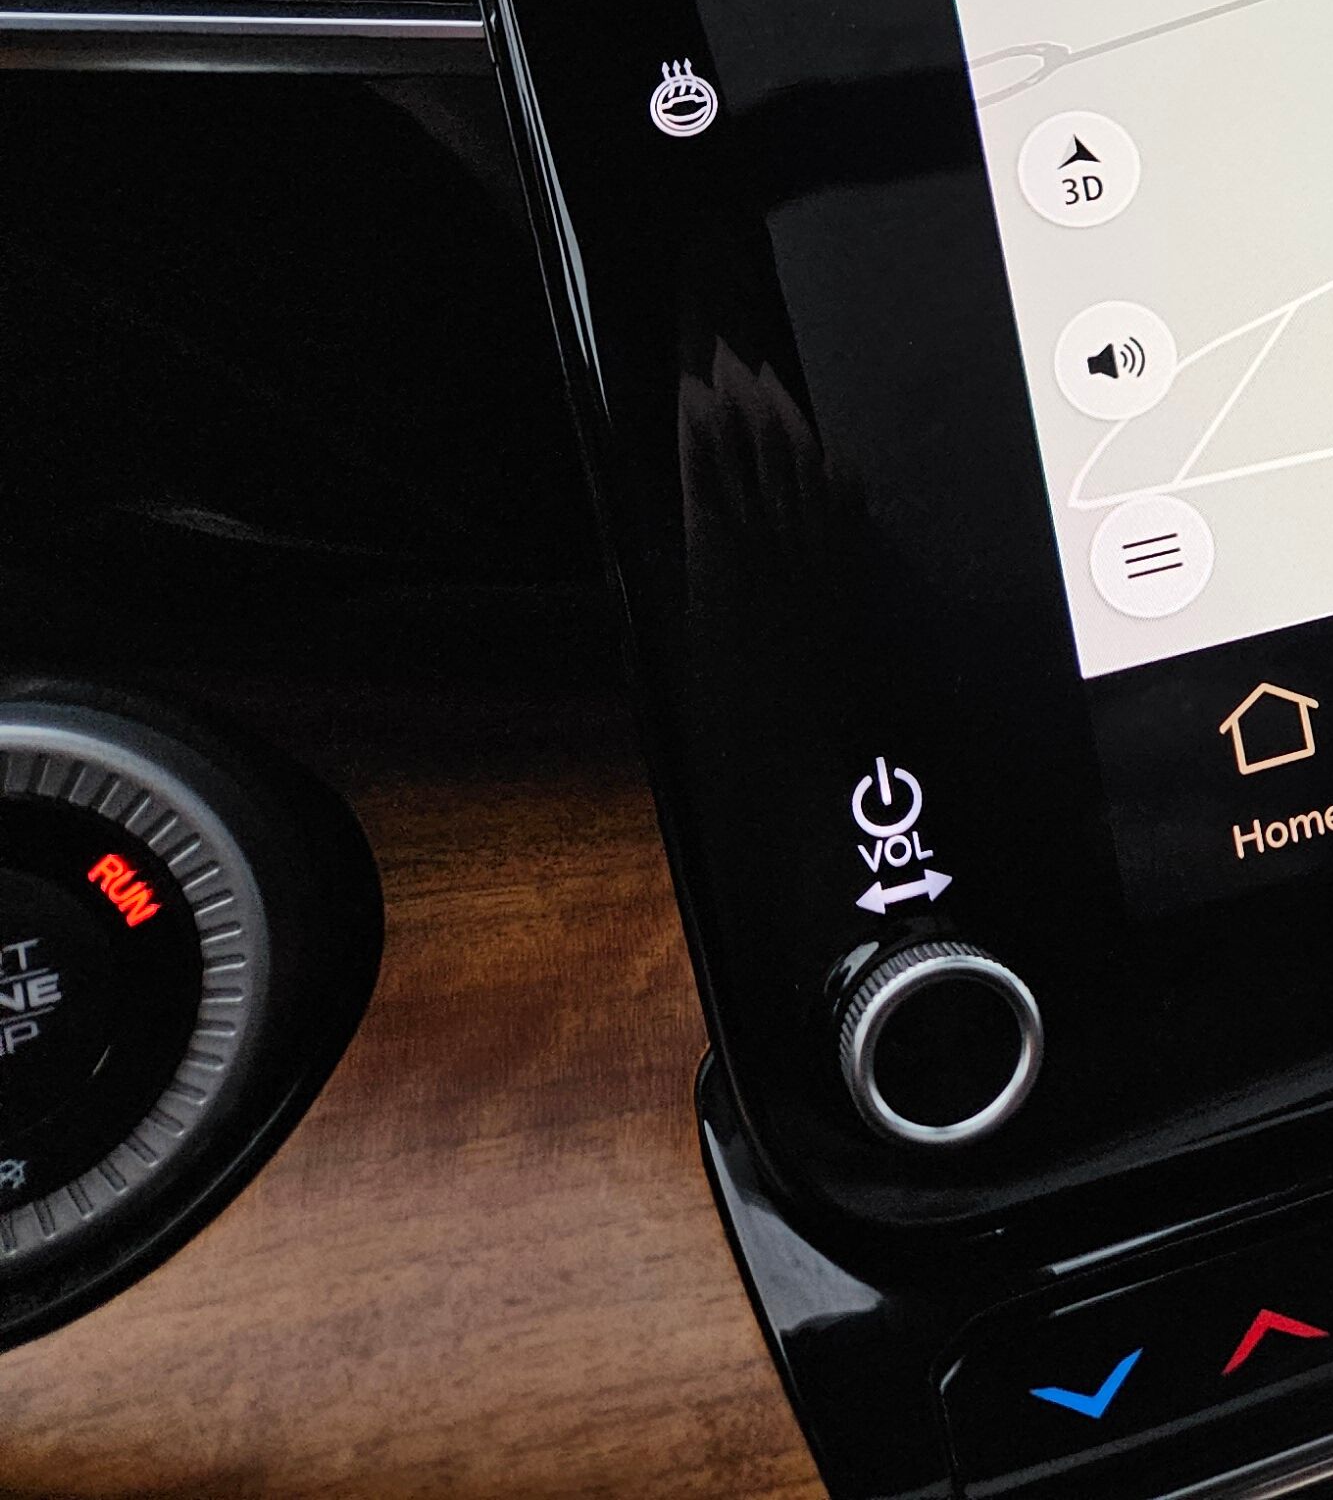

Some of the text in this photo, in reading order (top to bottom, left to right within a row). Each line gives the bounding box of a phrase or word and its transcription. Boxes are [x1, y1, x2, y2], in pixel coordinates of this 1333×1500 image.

[1061, 175, 1103, 204] 3D
[858, 832, 934, 873] VOL
[88, 853, 163, 927] RUN
[0, 938, 40, 971] T
[0, 1020, 40, 1055] P
